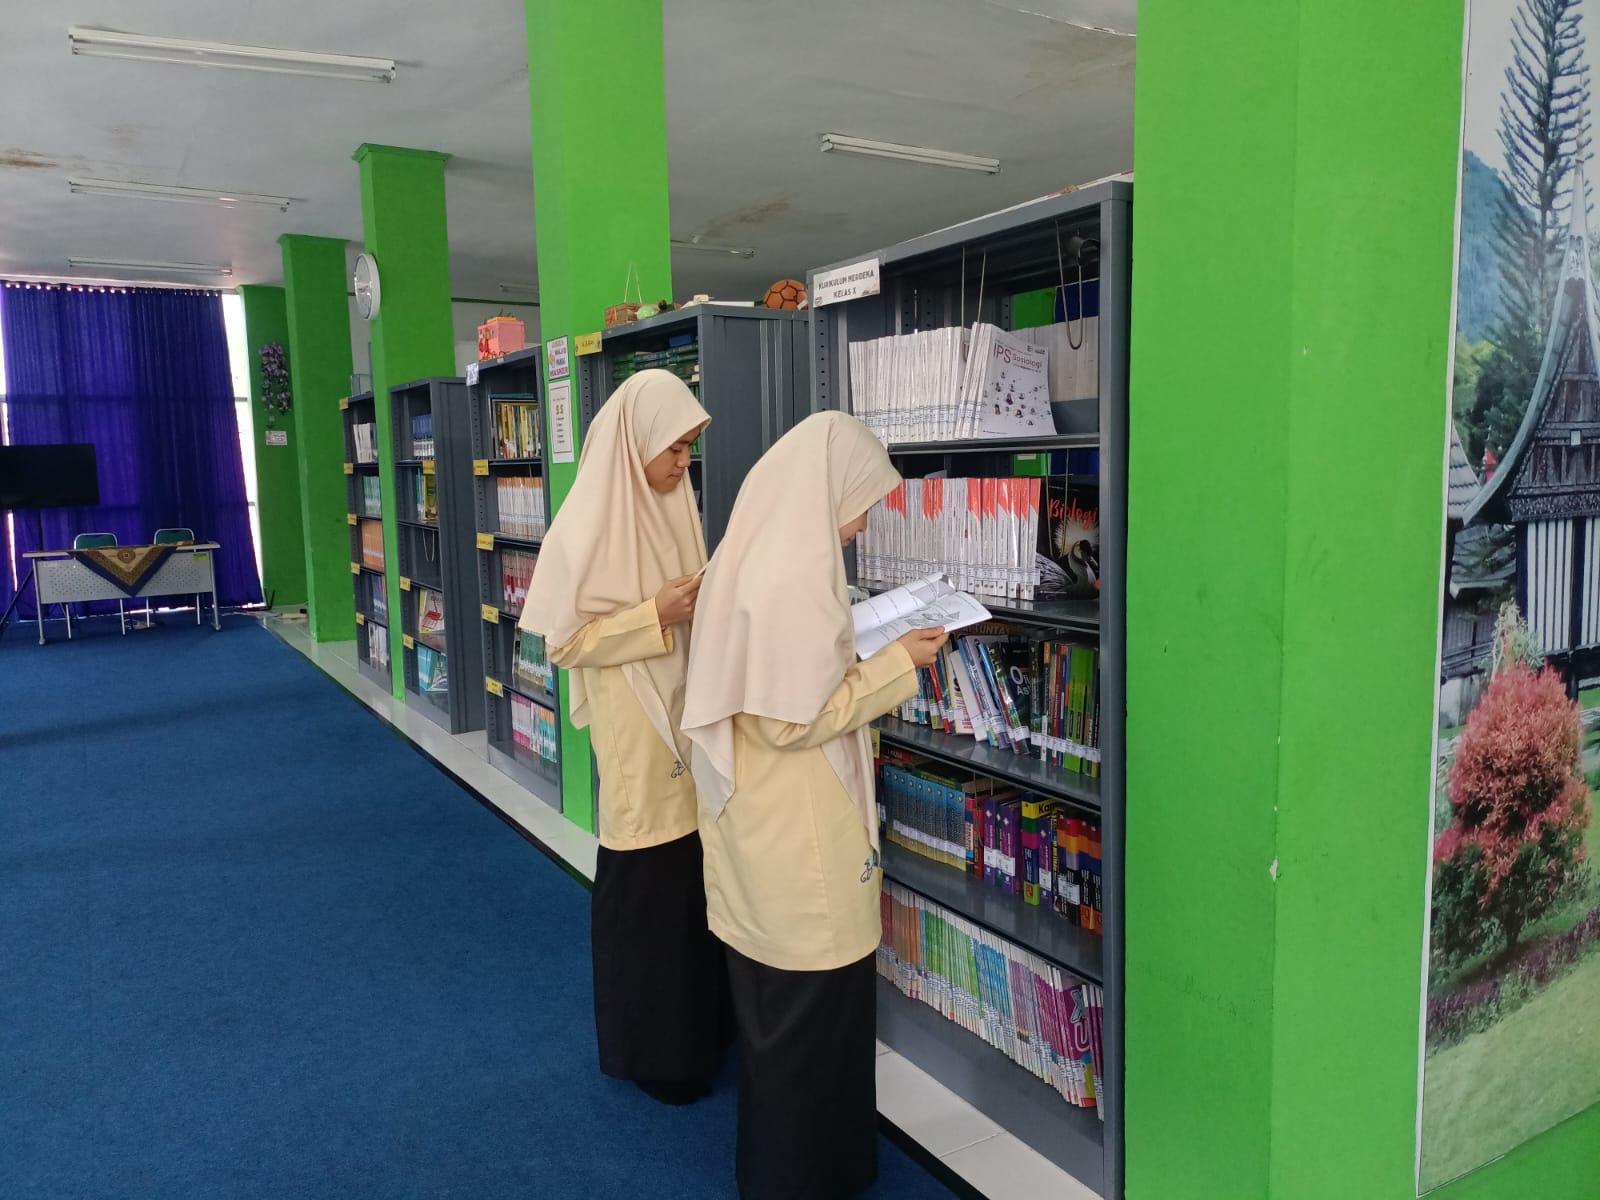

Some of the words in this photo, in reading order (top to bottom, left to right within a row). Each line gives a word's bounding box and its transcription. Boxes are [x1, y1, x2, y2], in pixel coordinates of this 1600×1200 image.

[818, 277, 847, 290] KURIKULUM
[848, 269, 874, 282] MERDEKA
[833, 288, 852, 298] KELAS
[852, 287, 857, 295] X
[993, 342, 1011, 364] IPS
[1012, 353, 1042, 370] Sosiologi
[1049, 497, 1098, 530] Biologi
